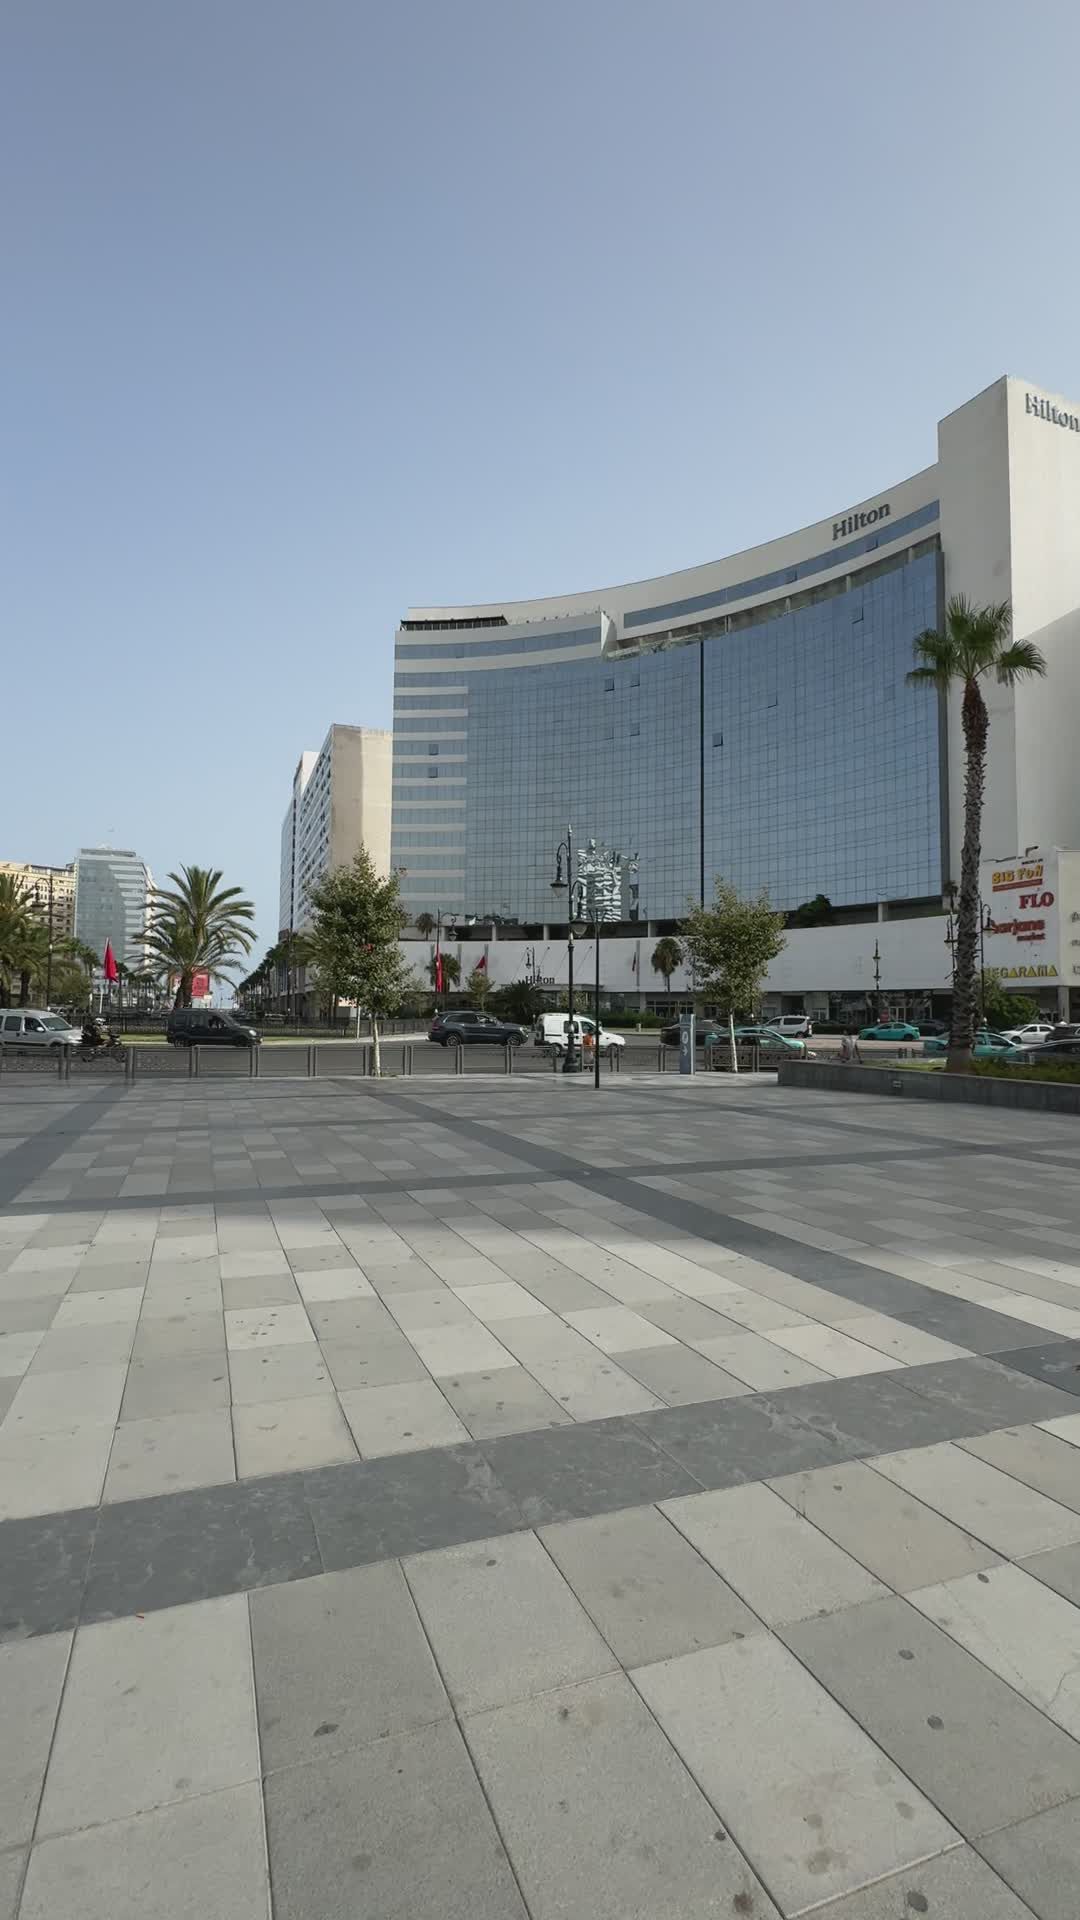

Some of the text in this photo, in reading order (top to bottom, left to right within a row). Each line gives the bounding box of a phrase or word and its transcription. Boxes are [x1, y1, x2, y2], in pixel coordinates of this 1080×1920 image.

[1026, 392, 1080, 432] Hilton
[832, 503, 890, 542] Hilton
[1018, 891, 1054, 909] FLO
[525, 975, 555, 984] Hton
